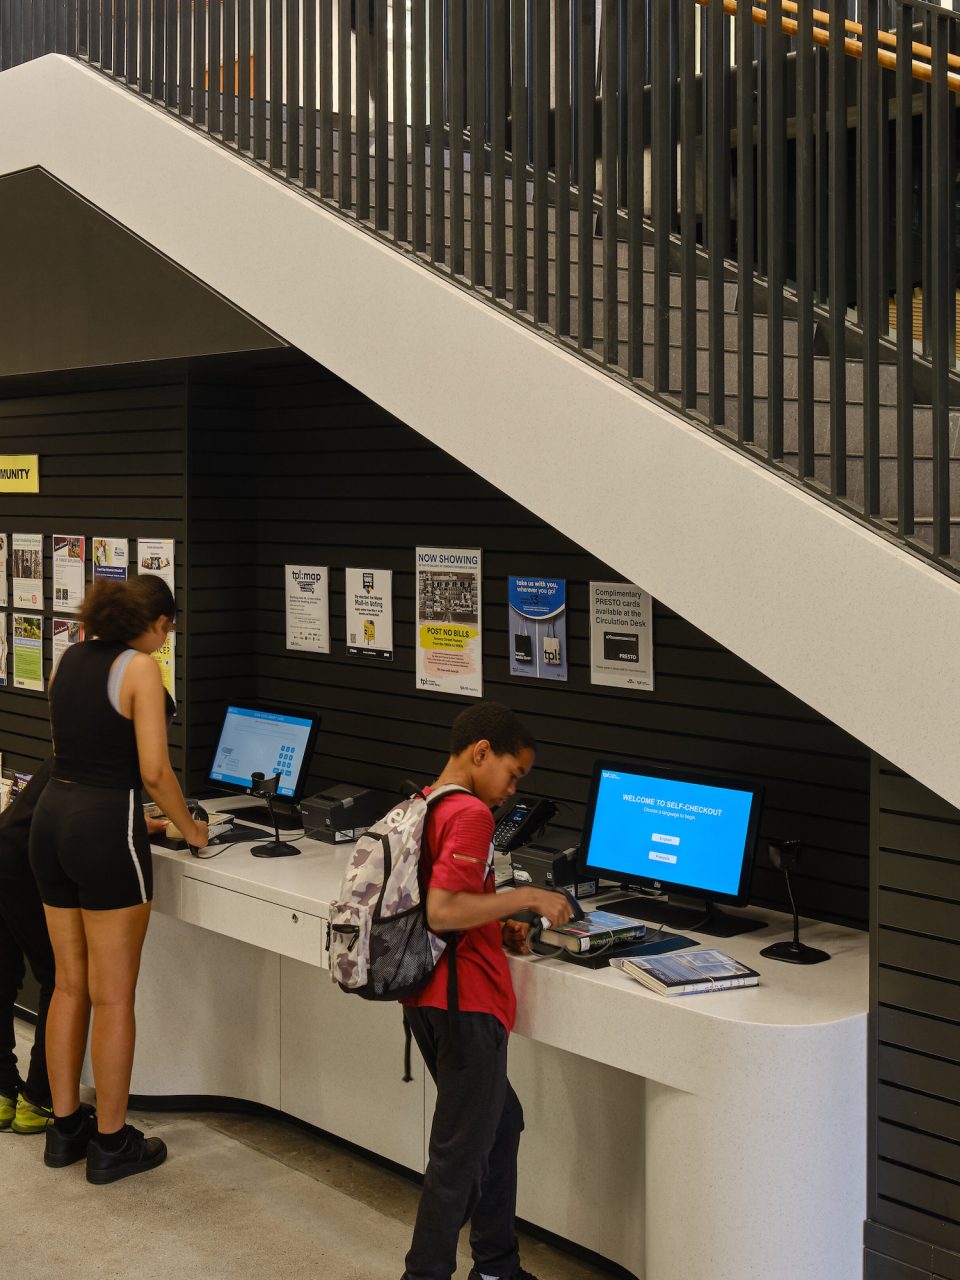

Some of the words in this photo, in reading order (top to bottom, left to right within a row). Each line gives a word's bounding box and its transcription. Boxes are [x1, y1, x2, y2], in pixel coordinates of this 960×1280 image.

[418, 553, 437, 563] NOW
[439, 554, 478, 565] SHOWING
[292, 570, 321, 583] tpl:map
[595, 588, 642, 599] Complimentary
[370, 600, 383, 609] Voting
[595, 598, 621, 607] PRESTO
[622, 600, 640, 608] cards
[595, 607, 622, 616] available
[623, 609, 629, 617] at
[631, 609, 641, 618] the
[595, 616, 629, 626] Circulation
[630, 618, 646, 627] Desk
[427, 627, 442, 635] POST
[443, 628, 453, 636] NO
[453, 629, 469, 638] BILLS
[622, 794, 655, 805] WELCOME
[656, 799, 666, 807] TO
[666, 801, 723, 817] SELF-CHECKOUT
